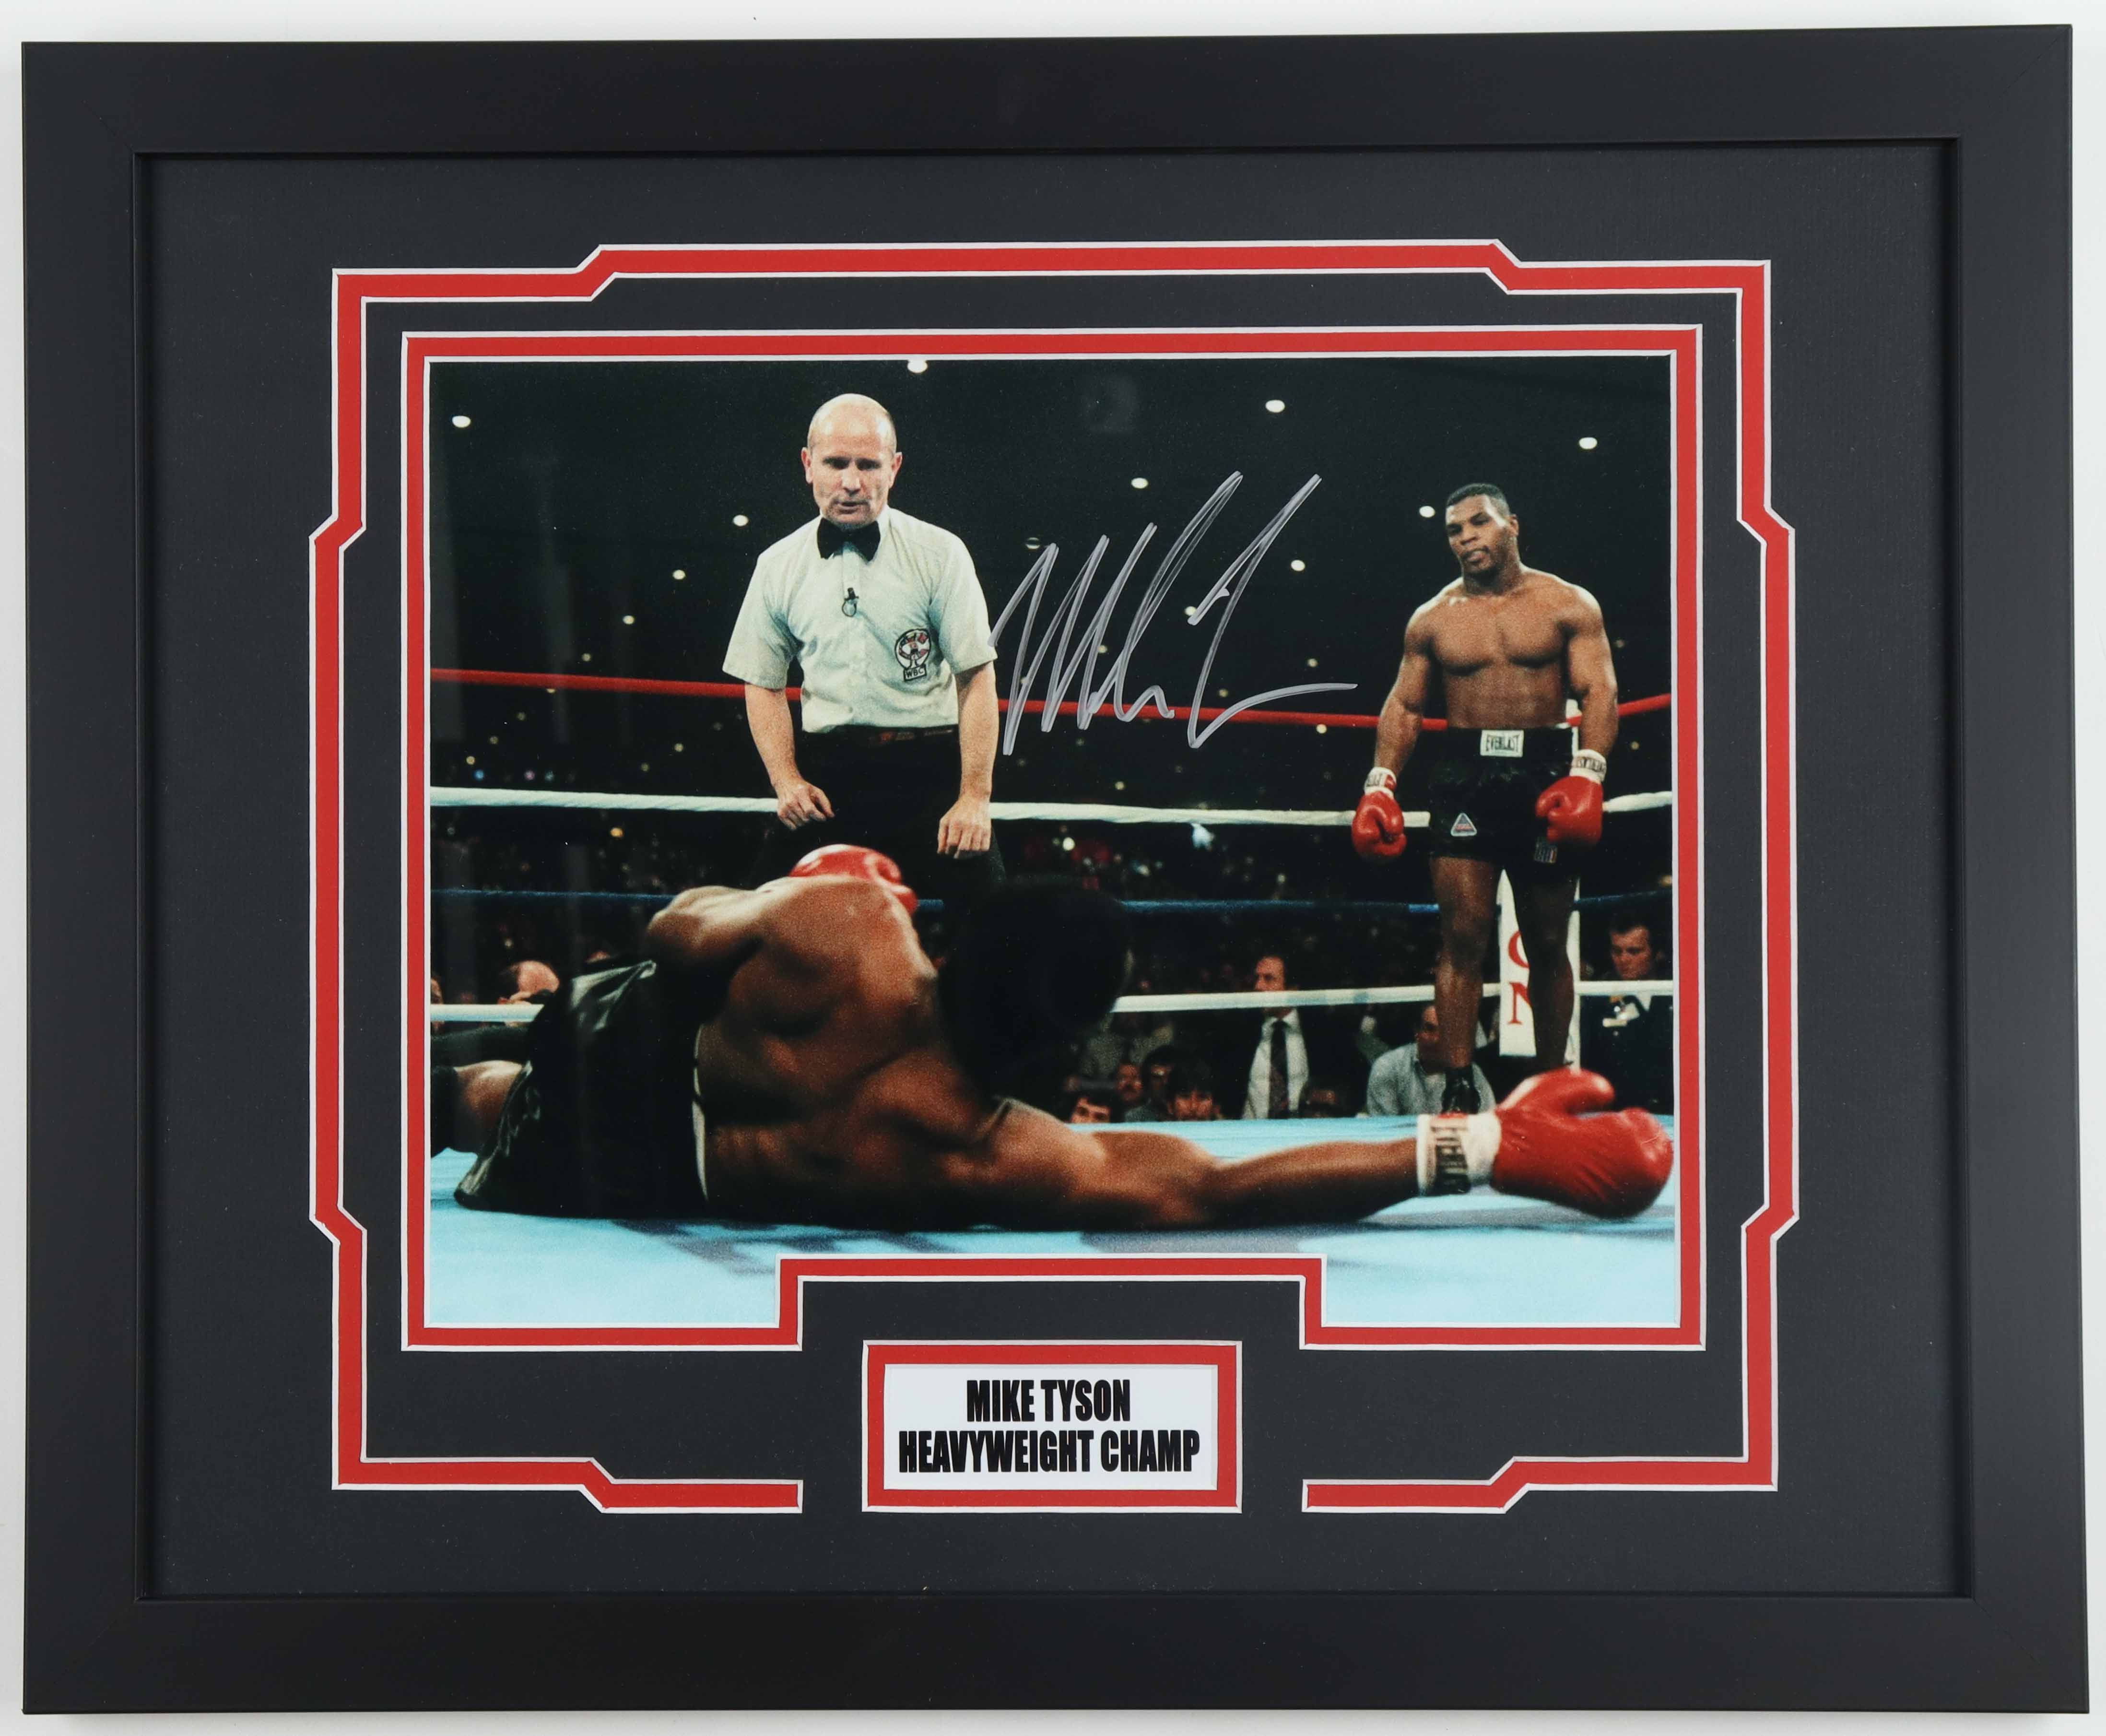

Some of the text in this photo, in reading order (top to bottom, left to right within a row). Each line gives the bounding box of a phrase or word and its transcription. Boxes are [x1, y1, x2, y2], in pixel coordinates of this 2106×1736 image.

[906, 669, 924, 678] WBC
[967, 1379, 1130, 1422] MIKE TYSON
[899, 1430, 1200, 1473] HEAVYWEIGHT CHAMP
